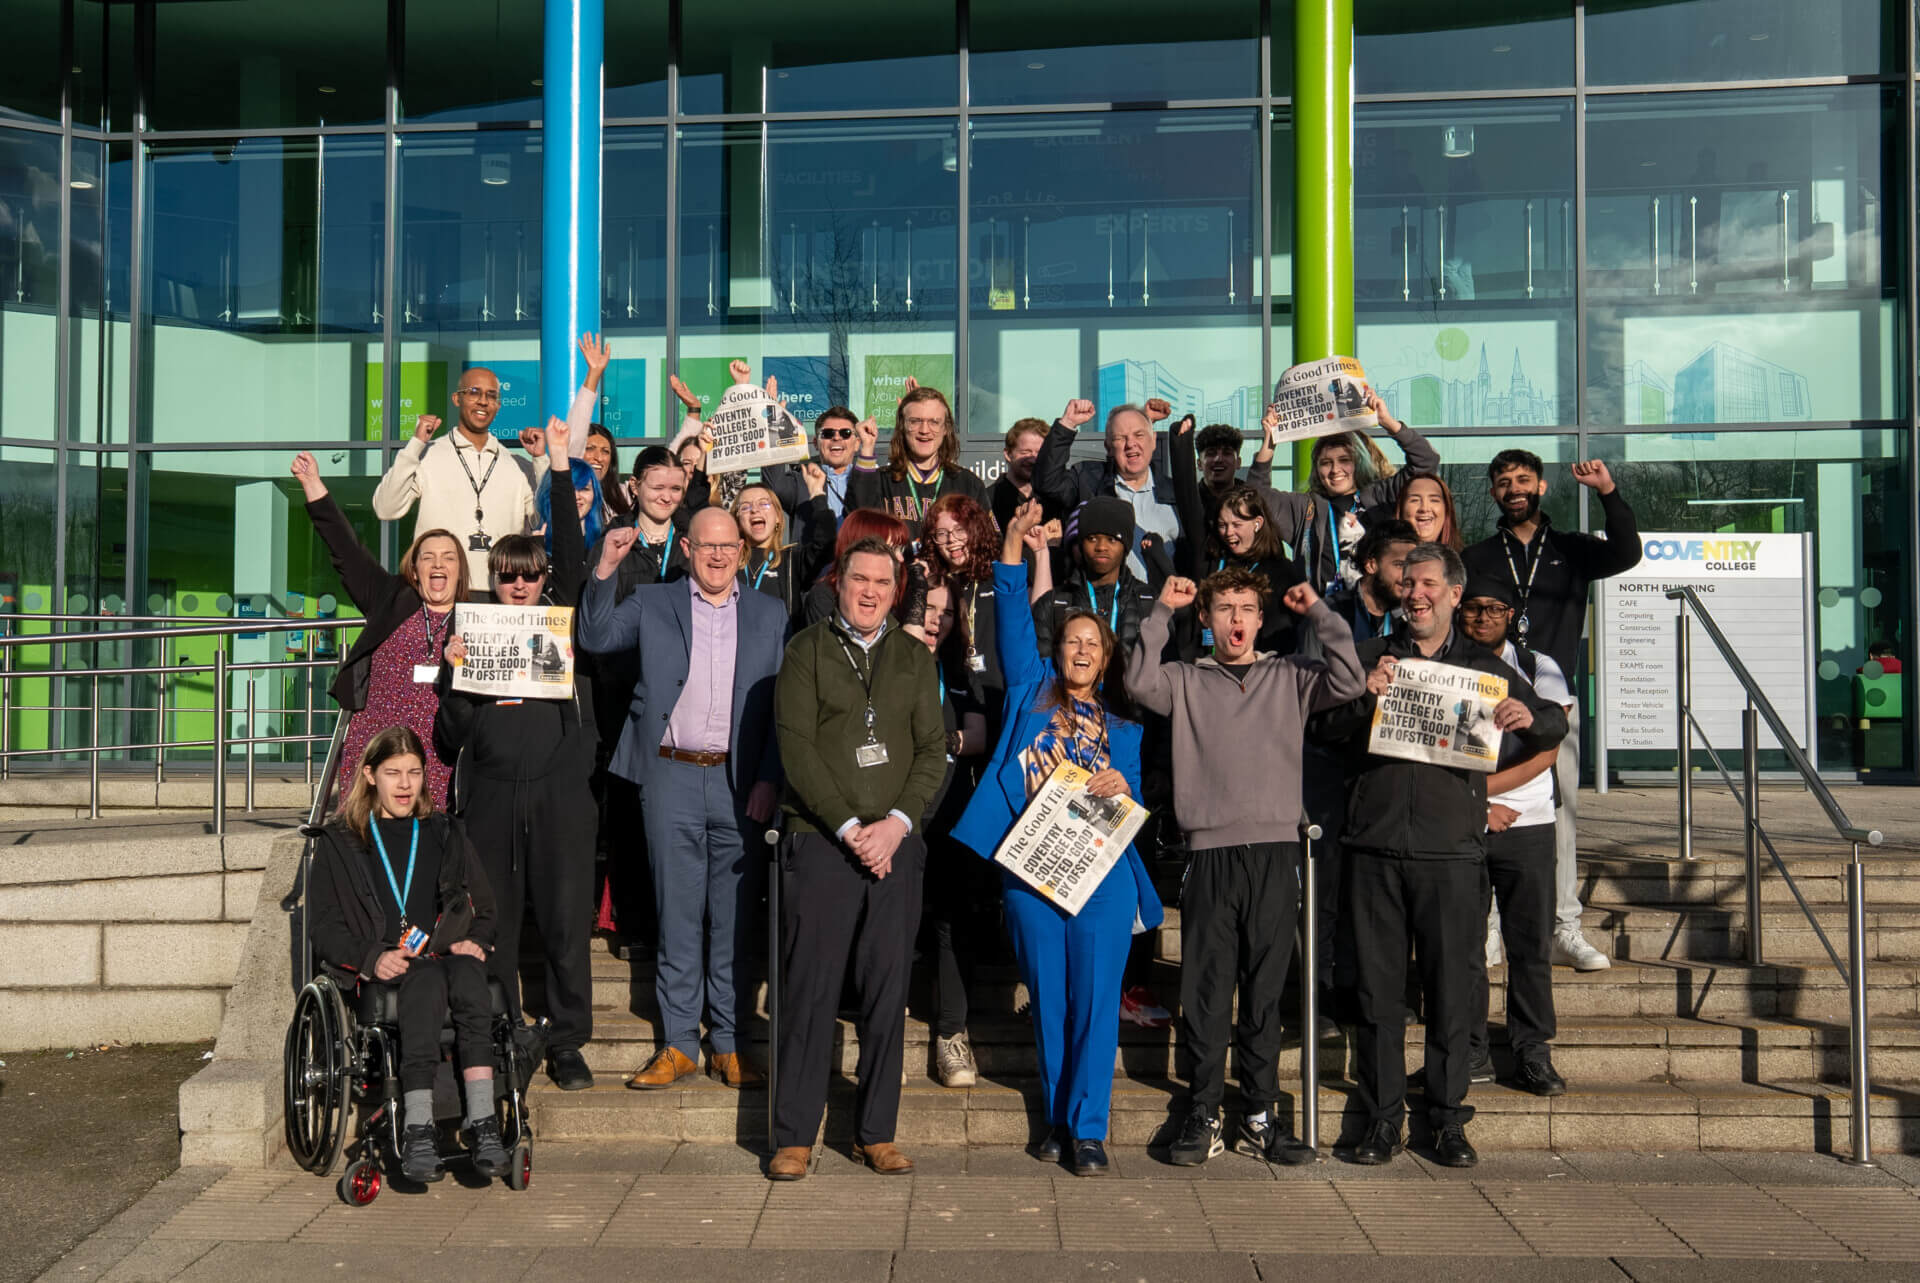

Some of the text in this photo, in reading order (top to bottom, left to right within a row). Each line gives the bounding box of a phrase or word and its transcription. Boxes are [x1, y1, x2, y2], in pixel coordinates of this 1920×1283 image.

[1096, 215, 1208, 235] EXPERTS
[1293, 366, 1322, 382] Good
[1323, 361, 1357, 375] Times
[729, 389, 758, 403] Good
[1274, 393, 1324, 413] COLLEGE IS
[713, 407, 752, 425] OVENTRY
[1277, 409, 1304, 423] RATED
[1278, 415, 1325, 432] BY OFSTED
[711, 418, 757, 437] COLLEGE IS
[712, 435, 738, 448] RATED
[712, 442, 756, 459] BY OFSTED
[1643, 540, 1761, 561] COVENTRY
[1705, 562, 1756, 571] COLLEGE
[1619, 584, 1659, 592] NORTH
[463, 611, 567, 626] The Good Times
[1619, 611, 1654, 620] Computing
[463, 631, 516, 645] COVENTY
[1619, 636, 1656, 645] Engineering
[509, 646, 519, 657] IS
[463, 658, 494, 669] RATED
[461, 667, 474, 679] BY
[1390, 663, 1500, 696] The Good Times
[1386, 685, 1443, 706] COVENTRY
[1637, 688, 1669, 696] Reception
[1383, 699, 1445, 721] COLLEGE IS
[1620, 712, 1637, 720] Print
[1381, 713, 1416, 729] RATED
[1380, 727, 1436, 746] BY OFSTED
[1005, 769, 1078, 861] The Good Times
[1023, 822, 1063, 874] COVENTRY
[1034, 827, 1078, 882] COLLEGE IS
[1046, 856, 1074, 890] RATED
[1057, 847, 1098, 899] BY OFSTED
